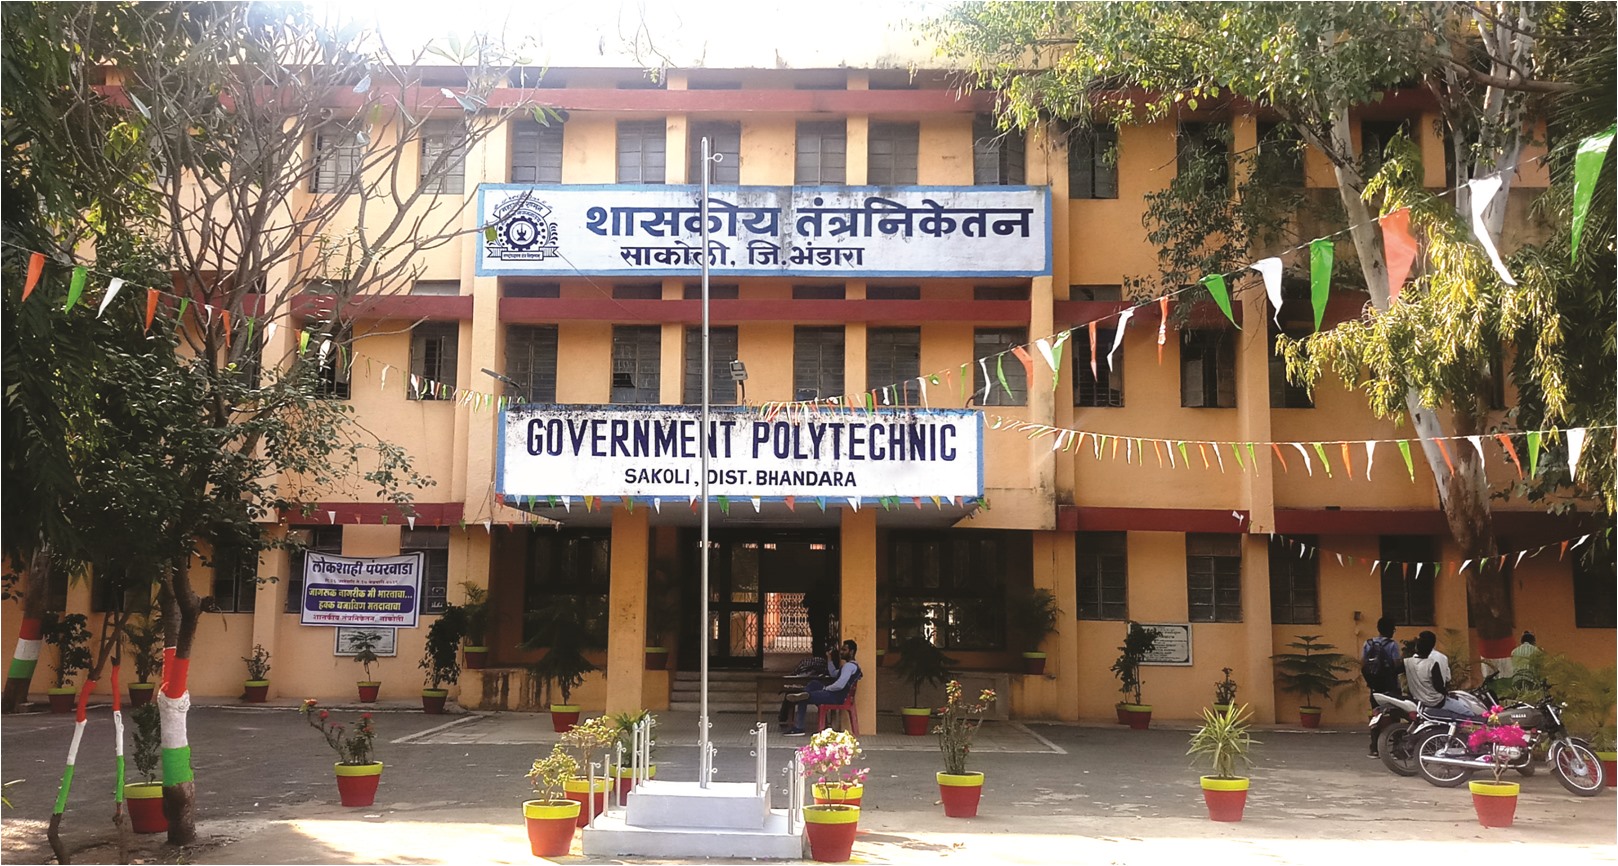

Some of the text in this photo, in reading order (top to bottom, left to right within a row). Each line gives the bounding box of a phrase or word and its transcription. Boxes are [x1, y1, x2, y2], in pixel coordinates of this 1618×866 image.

[586, 196, 1034, 238] शासकीय तंत्रनिकेतन
[526, 418, 957, 462] GOVERNMENT POLYTECHNIC
[624, 468, 700, 486] SAKOLI,
[312, 557, 363, 577] लोकशाही
